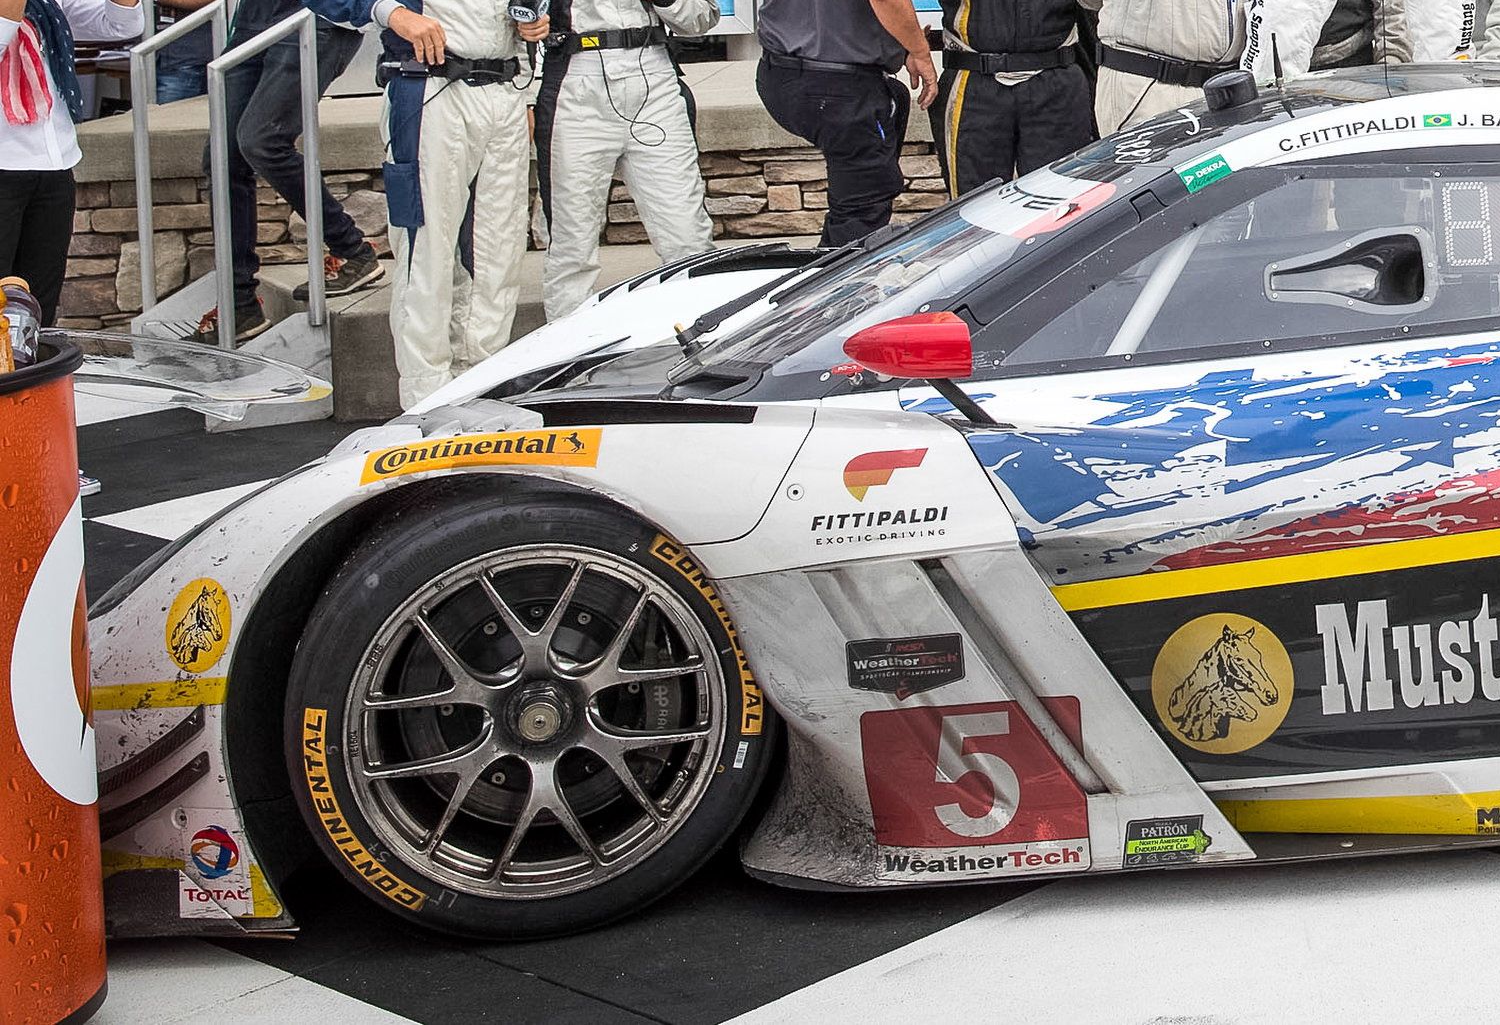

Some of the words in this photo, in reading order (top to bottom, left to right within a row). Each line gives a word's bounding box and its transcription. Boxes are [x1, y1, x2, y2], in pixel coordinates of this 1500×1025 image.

[513, 8, 530, 18] FOX
[1278, 115, 1416, 153] C.FITTIPALDI
[1458, 114, 1475, 128] J.
[1196, 159, 1227, 179] DEKRA
[373, 433, 555, 475] Continental
[810, 505, 949, 532] FITTIPALDI
[816, 533, 873, 546] EXOTIC
[879, 528, 946, 542] DRIVING
[853, 653, 958, 672] WeatherTech
[934, 710, 1021, 839] 5
[306, 710, 421, 909] CONTINENTAL
[883, 847, 1081, 876] WeatherTech
[183, 886, 250, 904] TOTAL
